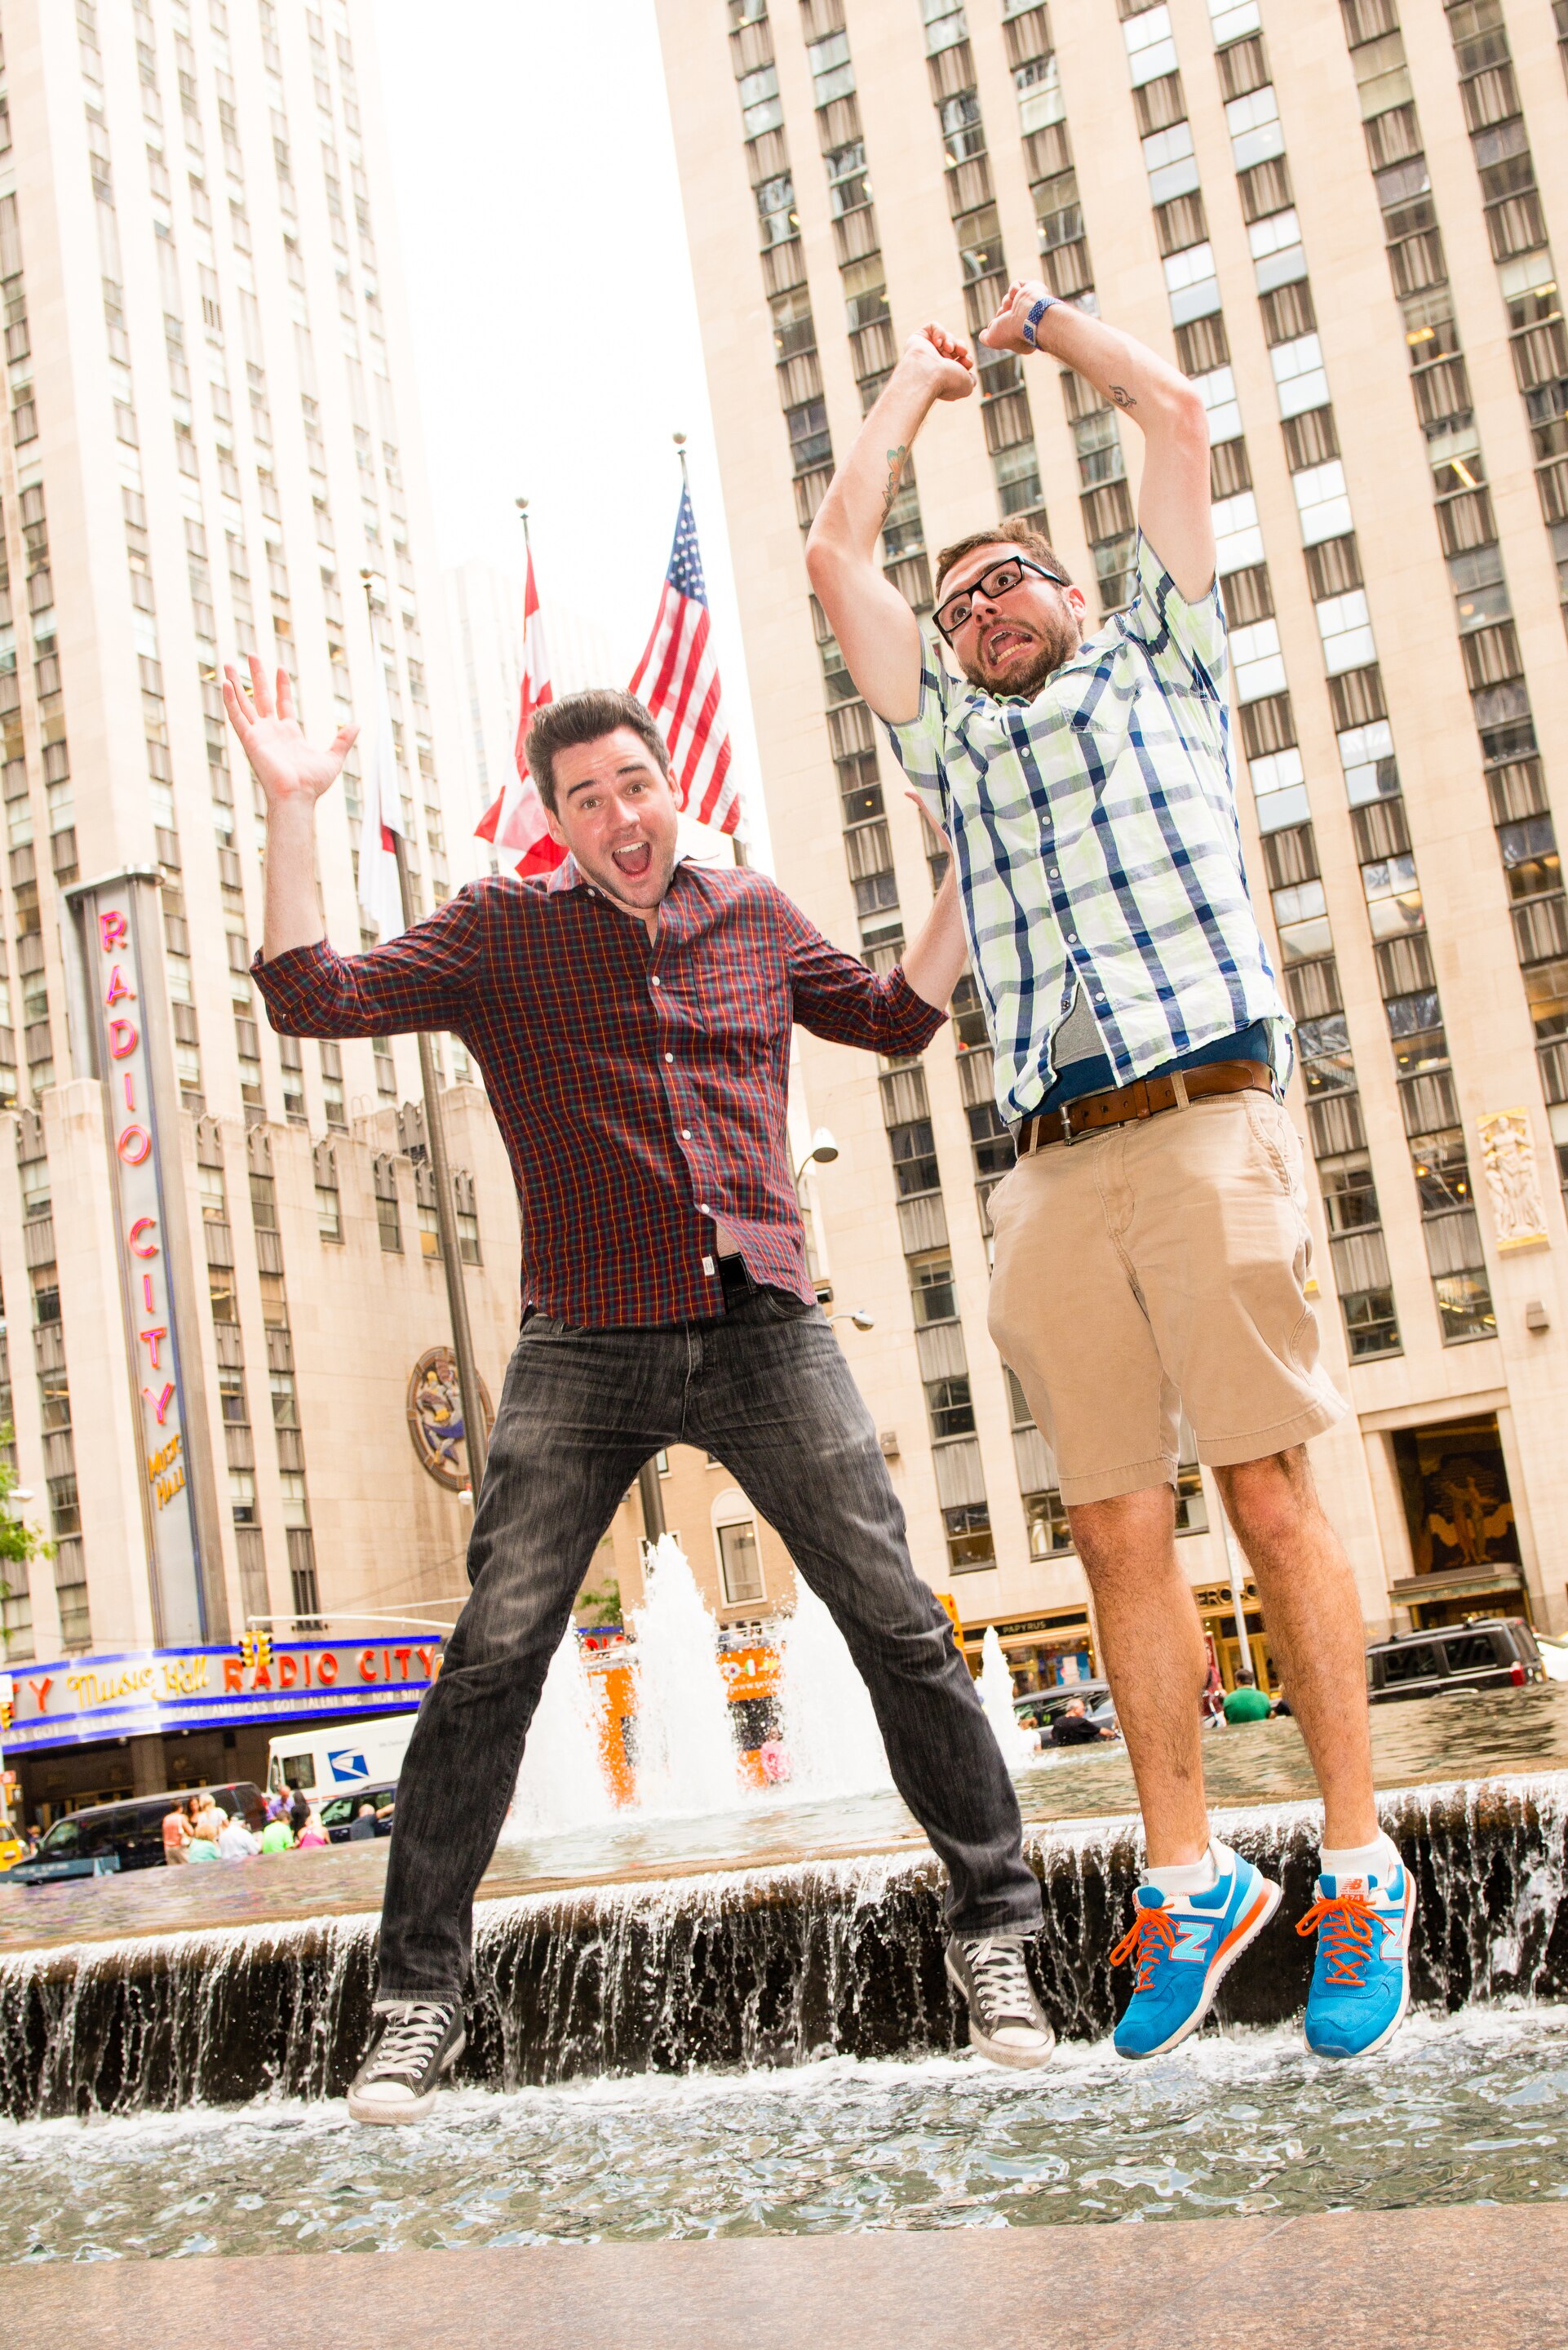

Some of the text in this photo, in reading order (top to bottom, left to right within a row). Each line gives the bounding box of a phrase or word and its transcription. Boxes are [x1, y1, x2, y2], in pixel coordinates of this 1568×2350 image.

[98, 910, 152, 1166] RADIO
[128, 1217, 175, 1425] CITY
[1002, 1621, 1047, 1634] PAPYRUS
[66, 1667, 155, 1709] Music
[151, 1655, 210, 1701] Hall
[222, 1645, 435, 1693] RADIO CITY
